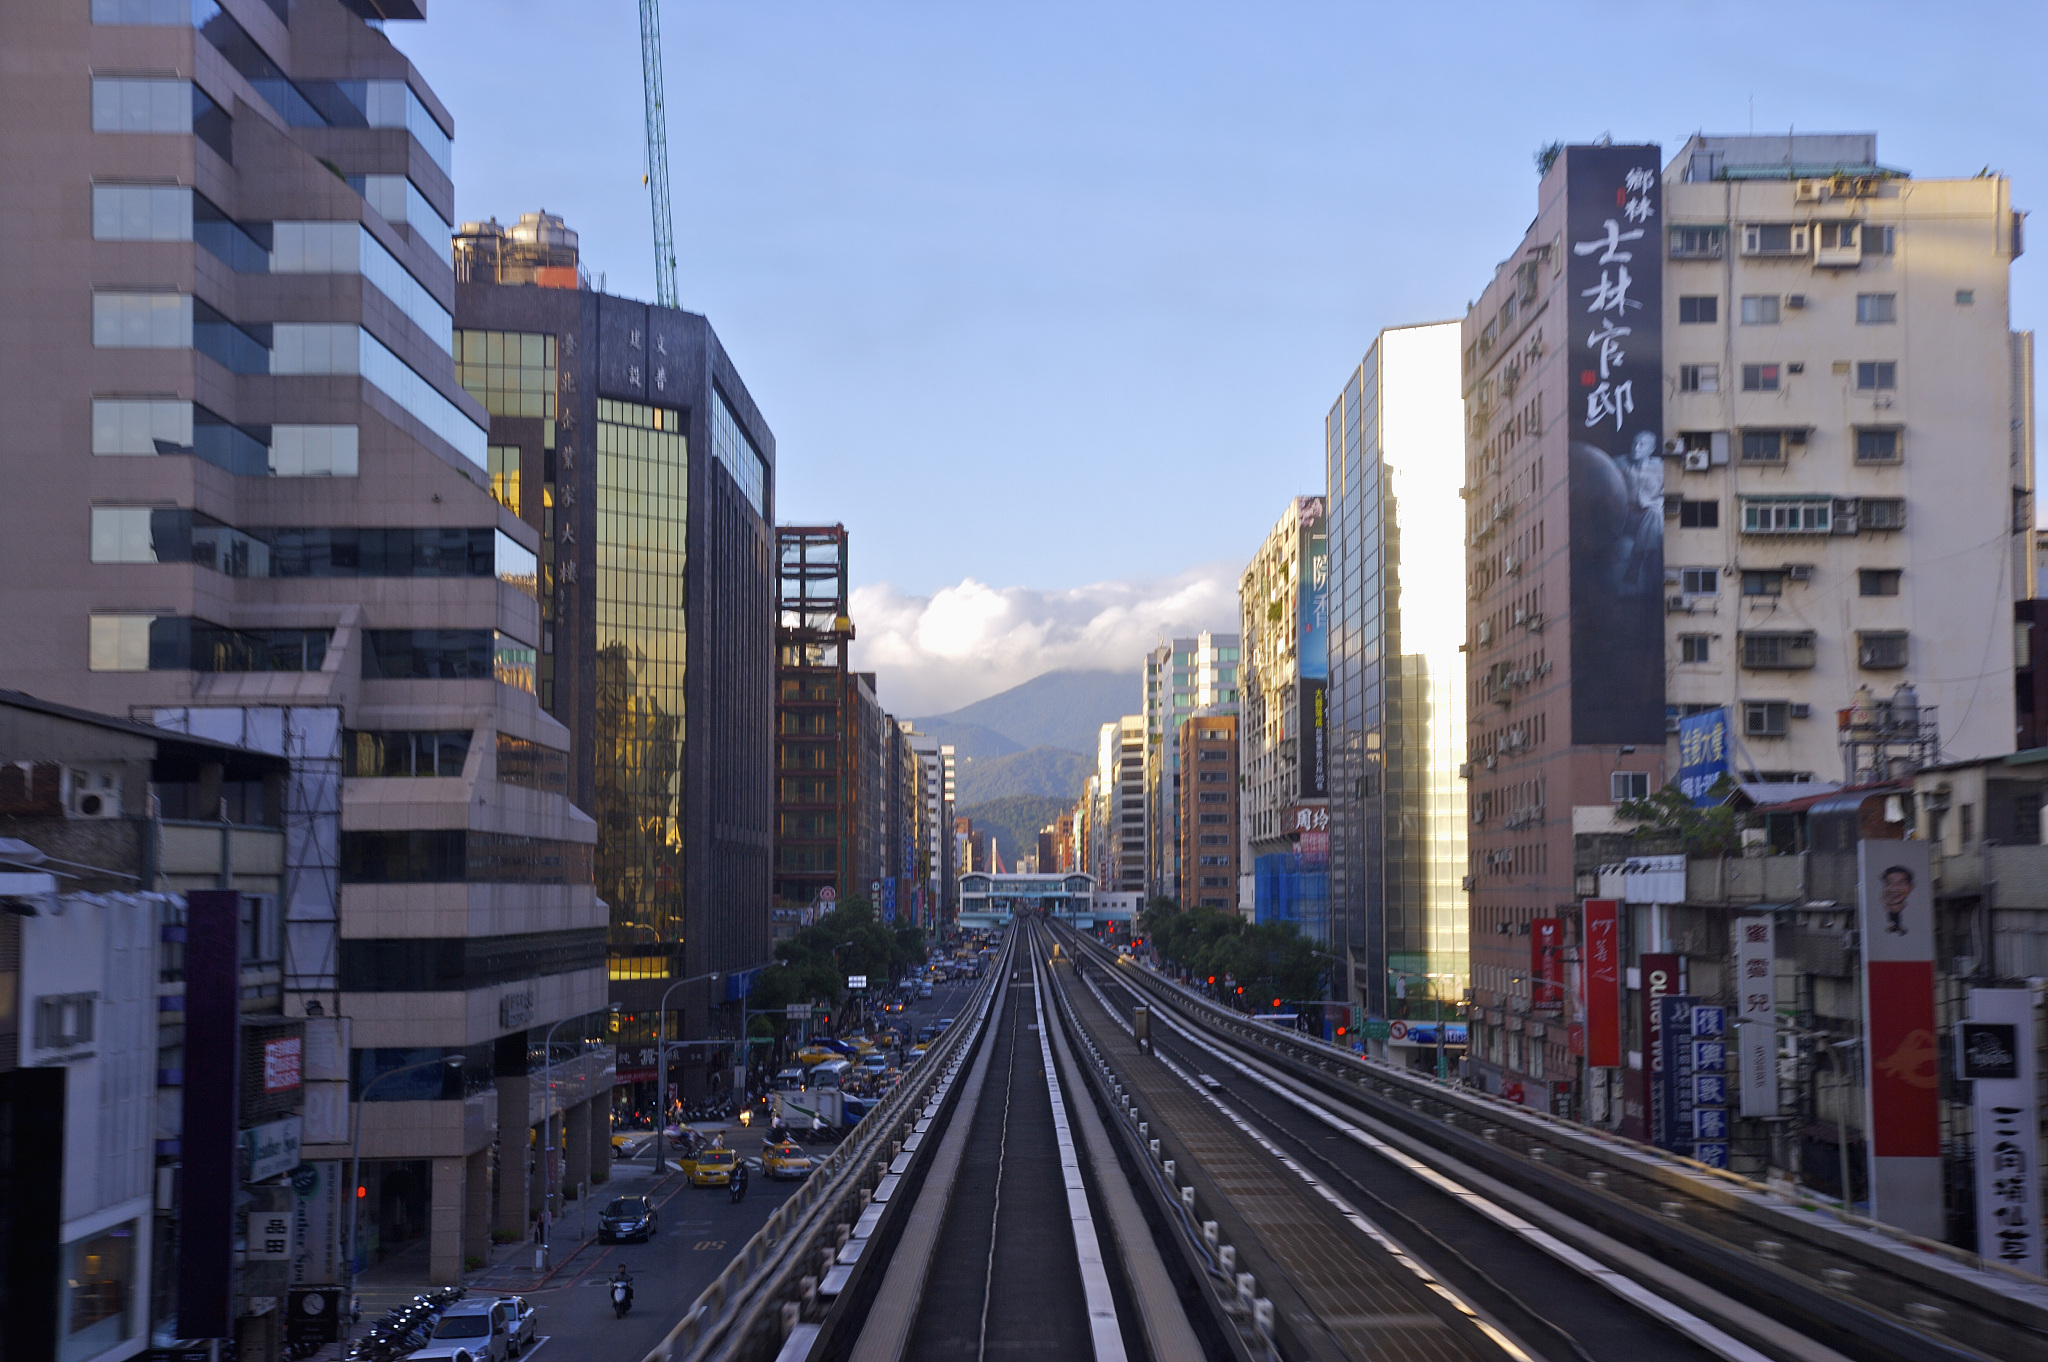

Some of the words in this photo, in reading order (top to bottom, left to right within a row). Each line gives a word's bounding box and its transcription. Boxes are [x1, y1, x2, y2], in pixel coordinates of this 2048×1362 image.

[1624, 166, 1655, 223] 鄉林
[1573, 218, 1645, 433] 士林官邸
[558, 331, 579, 585] 臺北企業家大樓
[885, 877, 896, 921] TOTO
[1697, 1010, 1726, 1167] 復興獸醫院
[264, 1218, 288, 1254] 品田
